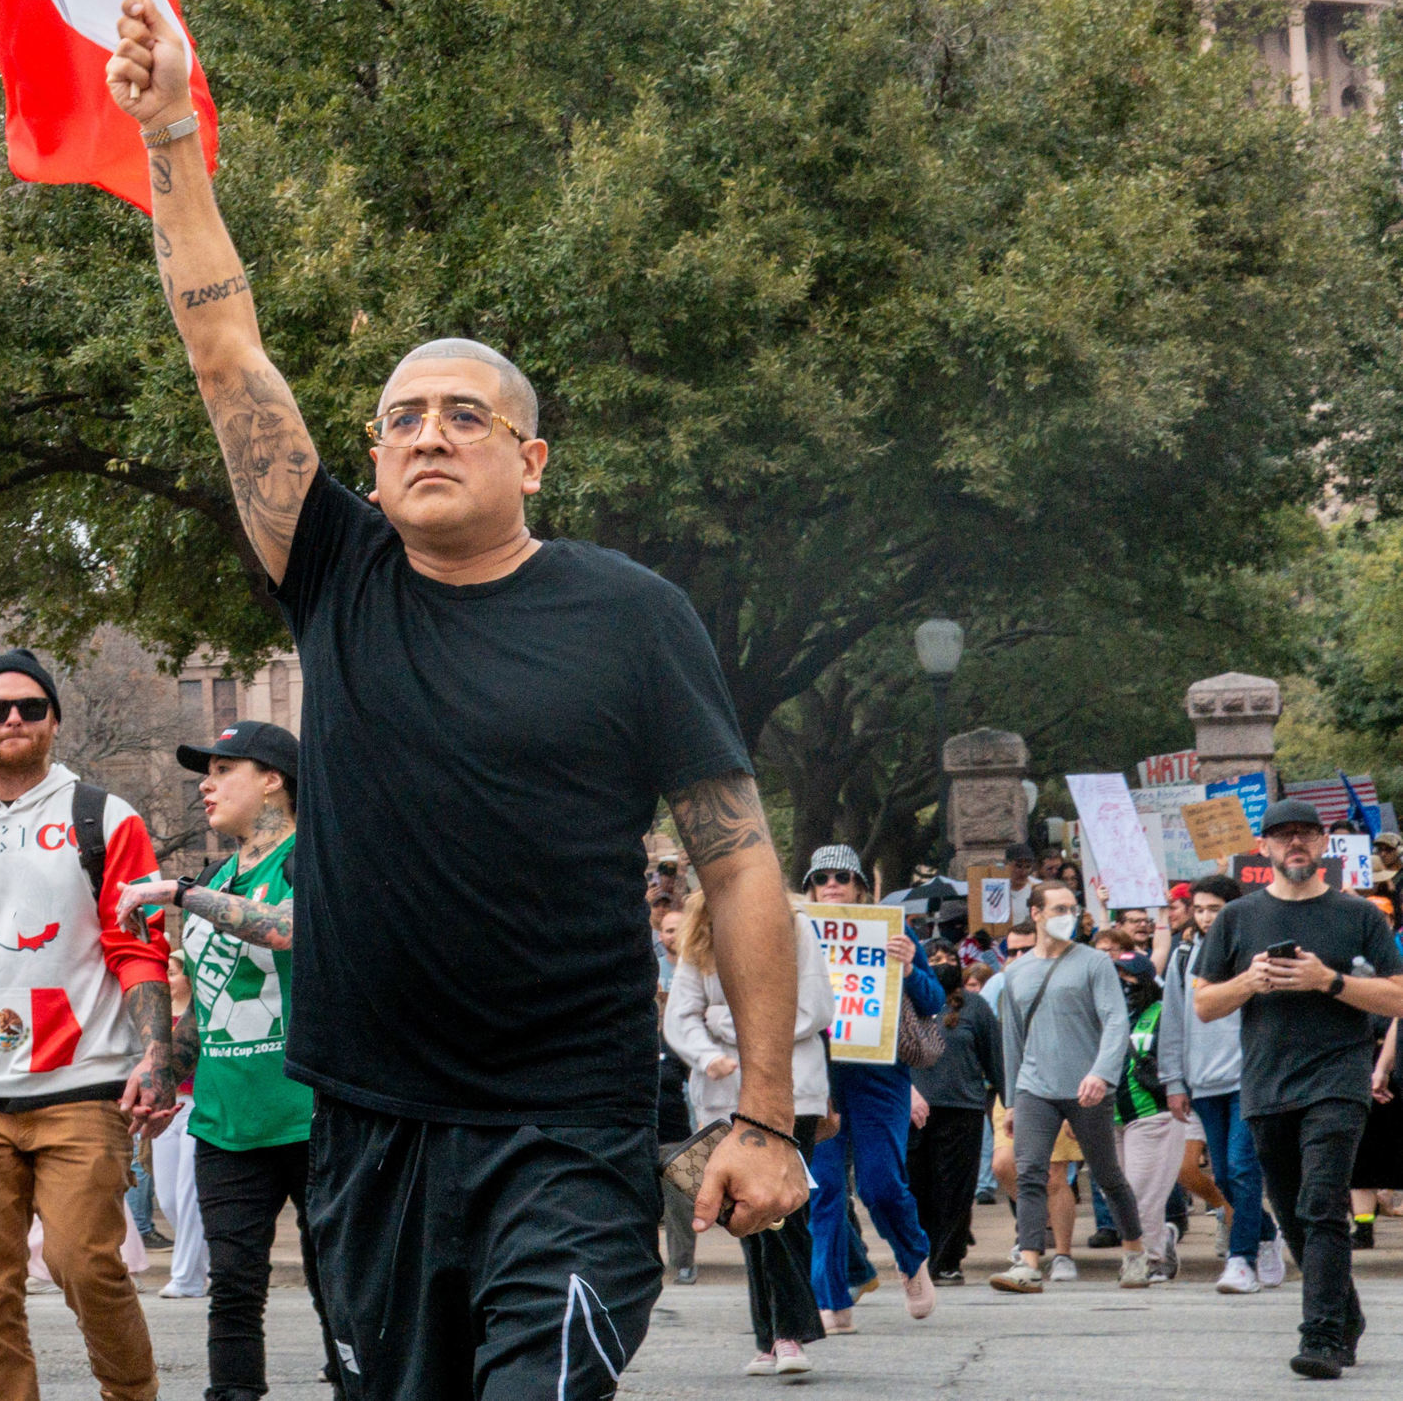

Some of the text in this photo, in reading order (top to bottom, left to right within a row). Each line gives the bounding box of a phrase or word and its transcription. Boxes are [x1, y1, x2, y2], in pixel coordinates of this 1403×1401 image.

[1146, 750, 1200, 784] HATE
[834, 995, 881, 1018] ING
[233, 1045, 253, 1058] Cup
